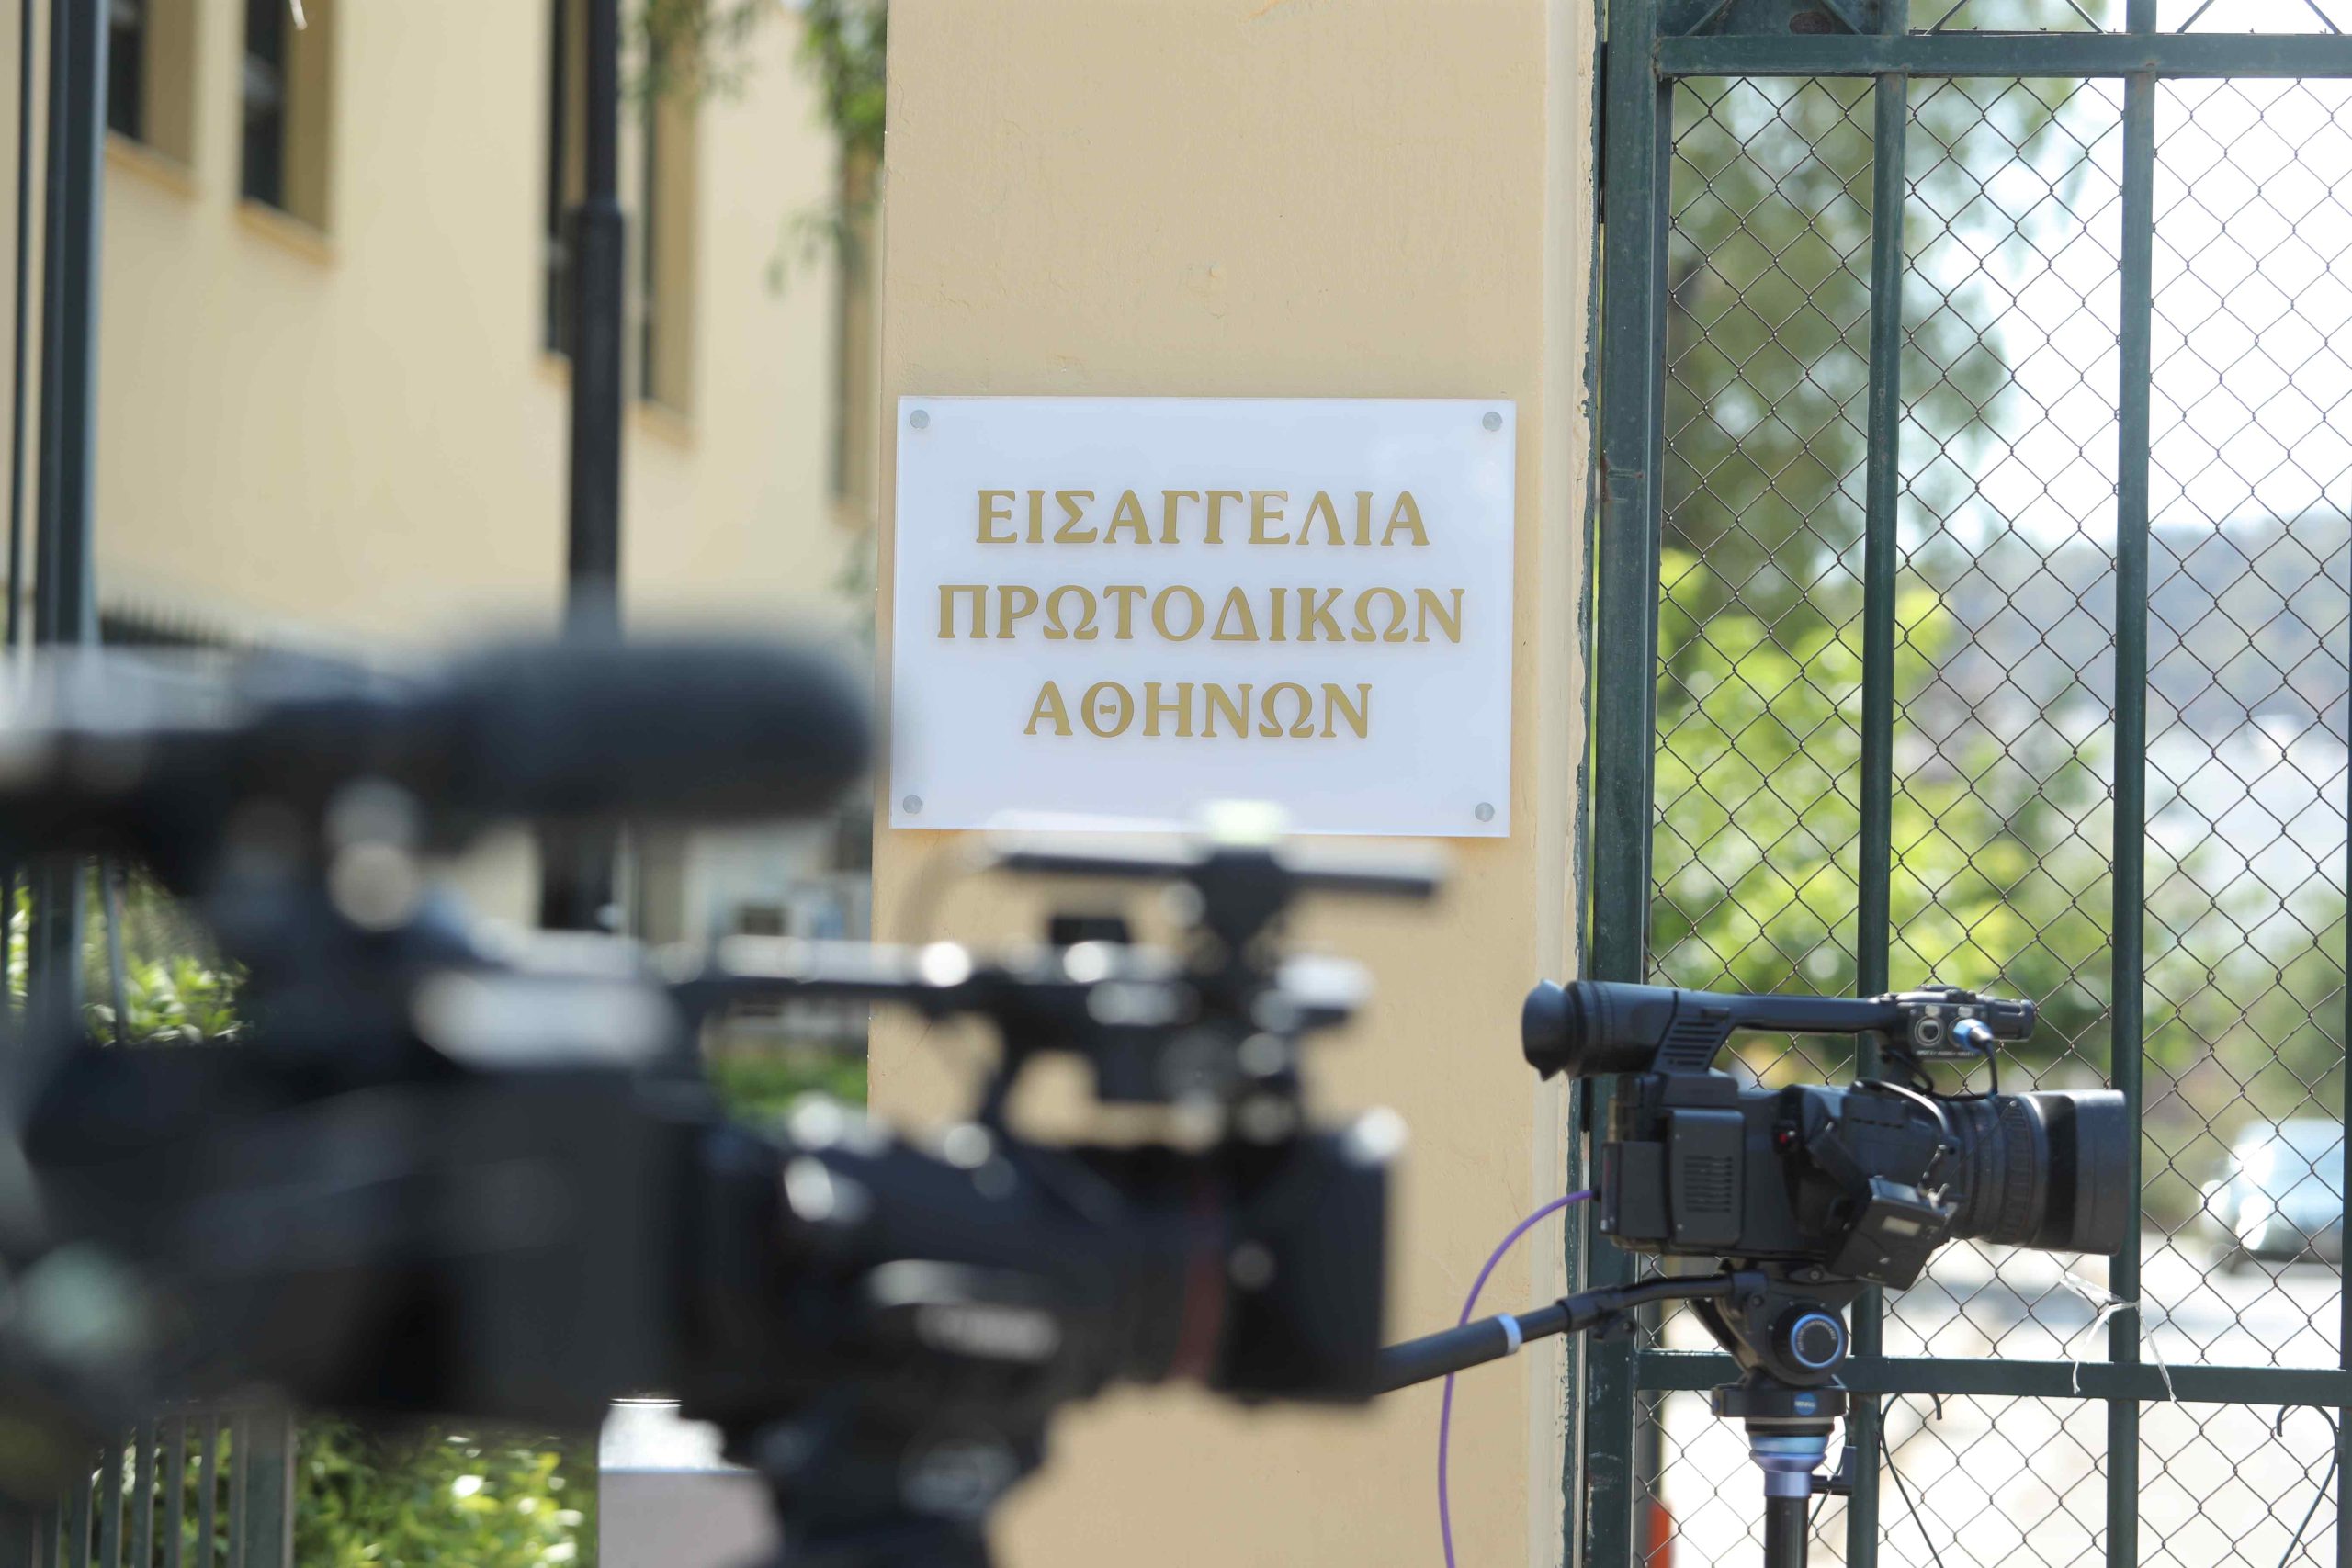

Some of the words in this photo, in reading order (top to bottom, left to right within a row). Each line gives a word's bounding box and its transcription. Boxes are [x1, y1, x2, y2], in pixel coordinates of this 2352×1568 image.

[977, 489, 1430, 547] ΕΙΣΑΓΓΕΛΙΑ
[937, 583, 1465, 644] ΠΡΩΤΟΔΙΚΩΝ
[1023, 680, 1373, 739] ΑΘΗΝΩΝ
